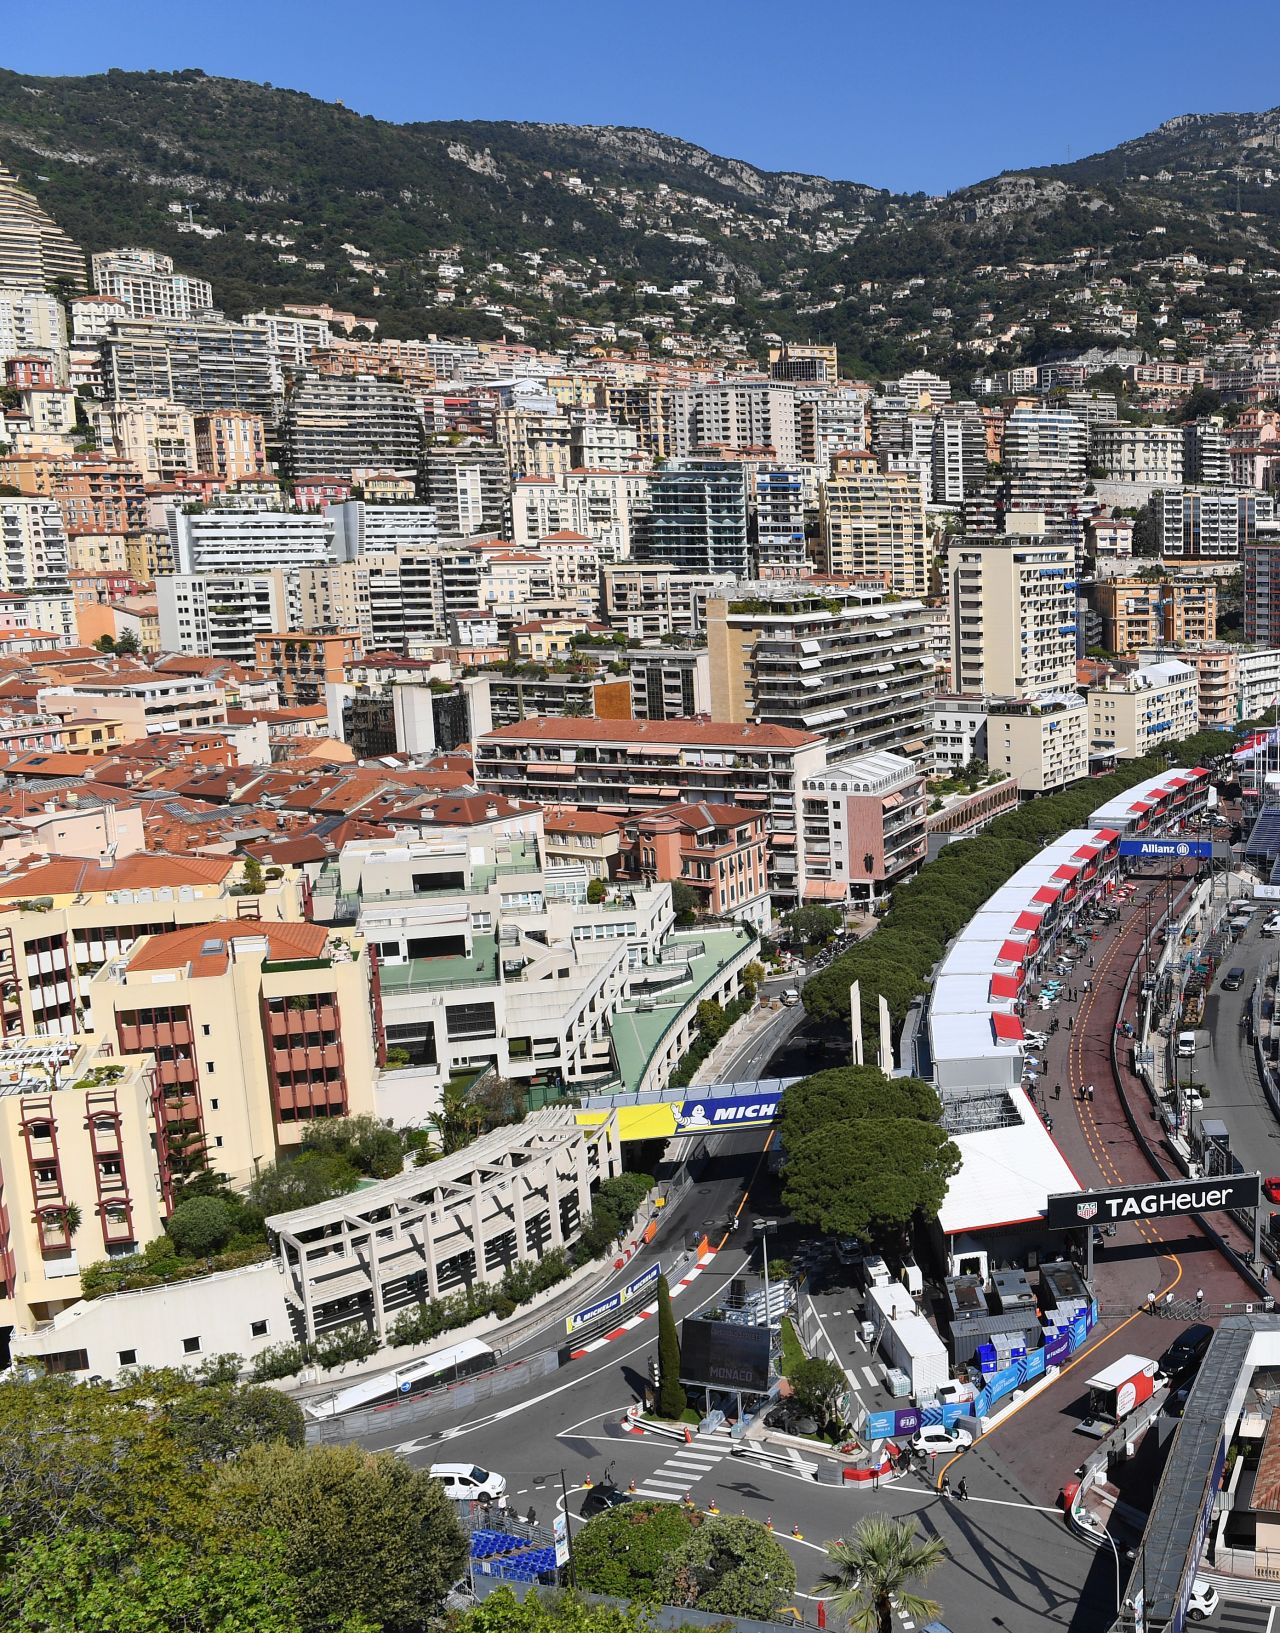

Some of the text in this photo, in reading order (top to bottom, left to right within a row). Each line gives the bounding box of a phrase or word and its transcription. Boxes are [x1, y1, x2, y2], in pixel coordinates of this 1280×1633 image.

[1141, 843, 1175, 853] Allianz
[713, 1103, 780, 1121] MICH
[1080, 1202, 1097, 1211] TAG
[633, 1269, 658, 1292] MICHELIN
[583, 1298, 618, 1321] MICHELIN
[709, 1366, 753, 1383] MONACO
[900, 1417, 917, 1428] FIA
